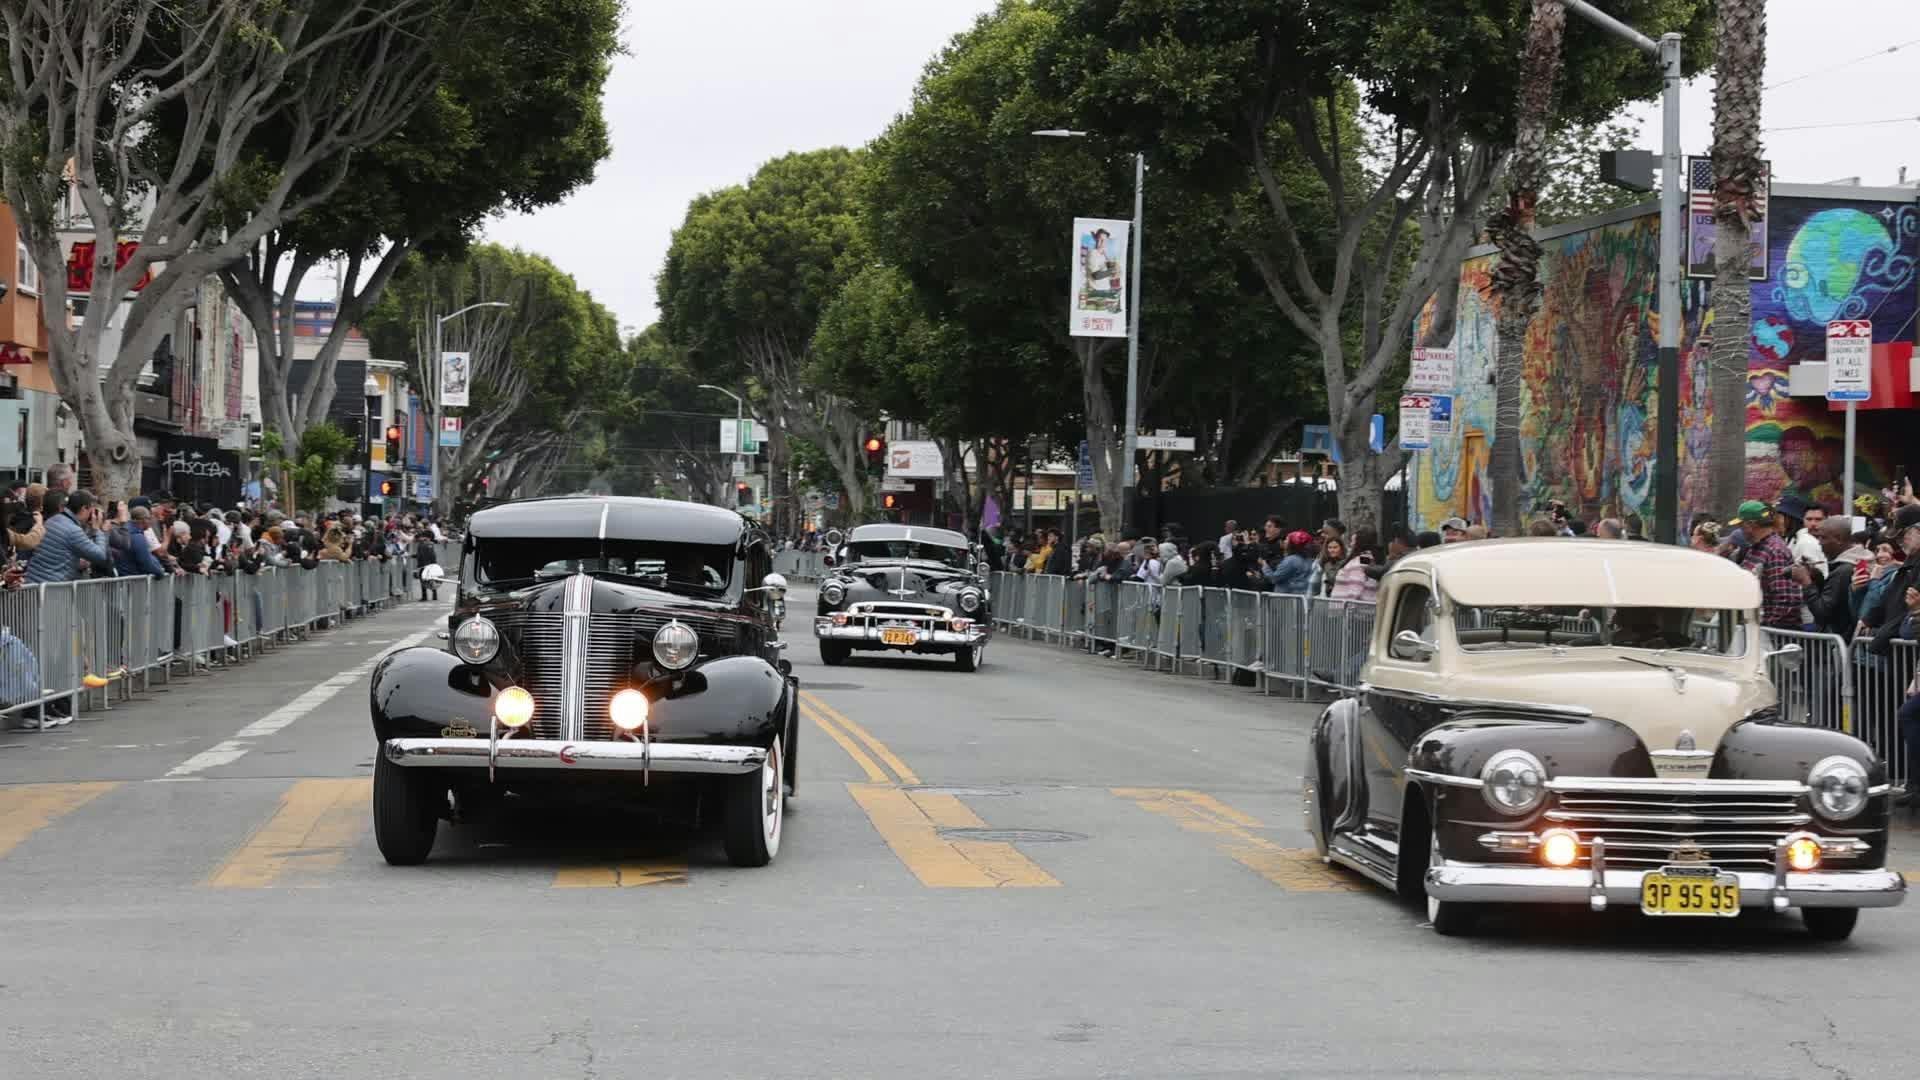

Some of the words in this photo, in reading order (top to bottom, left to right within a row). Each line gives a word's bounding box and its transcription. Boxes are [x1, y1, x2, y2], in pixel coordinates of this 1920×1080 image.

[1696, 215, 1713, 225] US
[1413, 349, 1425, 359] NO
[1836, 357, 1845, 365] AT
[1848, 357, 1864, 365] ALL
[1153, 439, 1177, 448] Lilac
[1647, 884, 1672, 908] 3P
[1679, 884, 1704, 908] 95
[1711, 885, 1735, 909] 95
